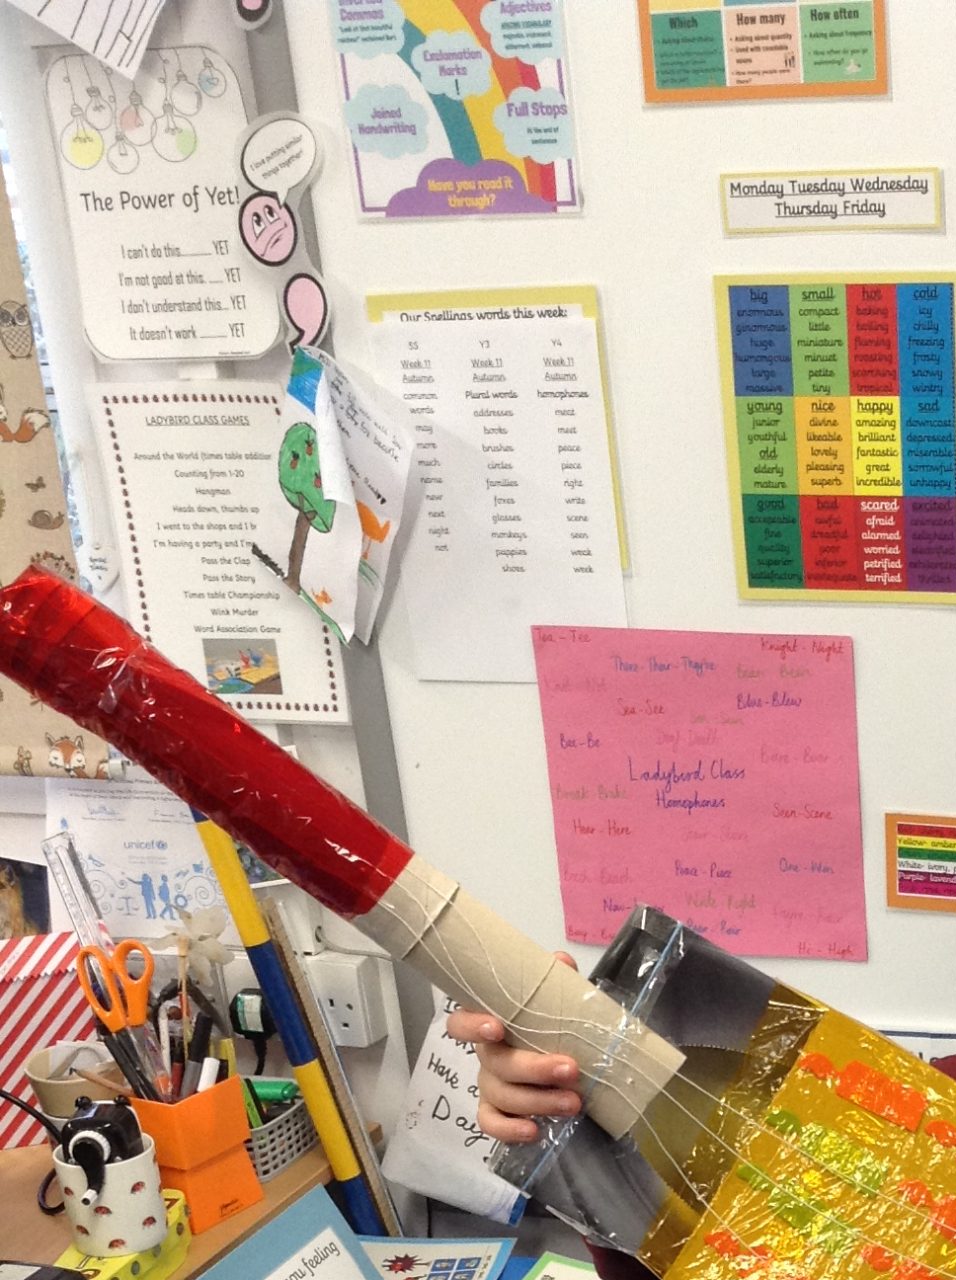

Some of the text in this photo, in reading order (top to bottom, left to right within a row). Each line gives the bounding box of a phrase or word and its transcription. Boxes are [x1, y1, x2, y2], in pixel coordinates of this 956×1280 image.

[736, 13, 785, 26] How many
[810, 8, 859, 22] How often
[669, 17, 698, 29] Which
[371, 108, 402, 119] Joined
[507, 103, 567, 118] Full Stops
[358, 123, 416, 135] Handwriting
[428, 176, 513, 192] Have you read it
[730, 177, 928, 198] Monday Tuesday Wednesday
[80, 185, 239, 212] The Power of Yet!
[448, 195, 496, 208] through?
[775, 201, 886, 219] Thursday Friday
[127, 241, 228, 258] can't do YET
[802, 288, 834, 301] small
[913, 289, 938, 300] cold
[476, 309, 510, 320] words
[513, 308, 534, 319] this
[537, 306, 567, 318] week:
[908, 338, 944, 350] freezing
[811, 401, 835, 413] nice
[857, 400, 893, 417] happy
[918, 401, 940, 412] sad
[146, 416, 249, 426] LADYBIRD CLASS GAMES
[174, 469, 244, 479] Counting from 1-20
[861, 501, 899, 512] scared
[865, 573, 902, 585] terrified
[211, 608, 259, 616] Wink Murder
[711, 759, 745, 780] Class
[124, 841, 154, 849] unicef
[428, 1053, 458, 1088] Have
[302, 1241, 341, 1276] feeling
